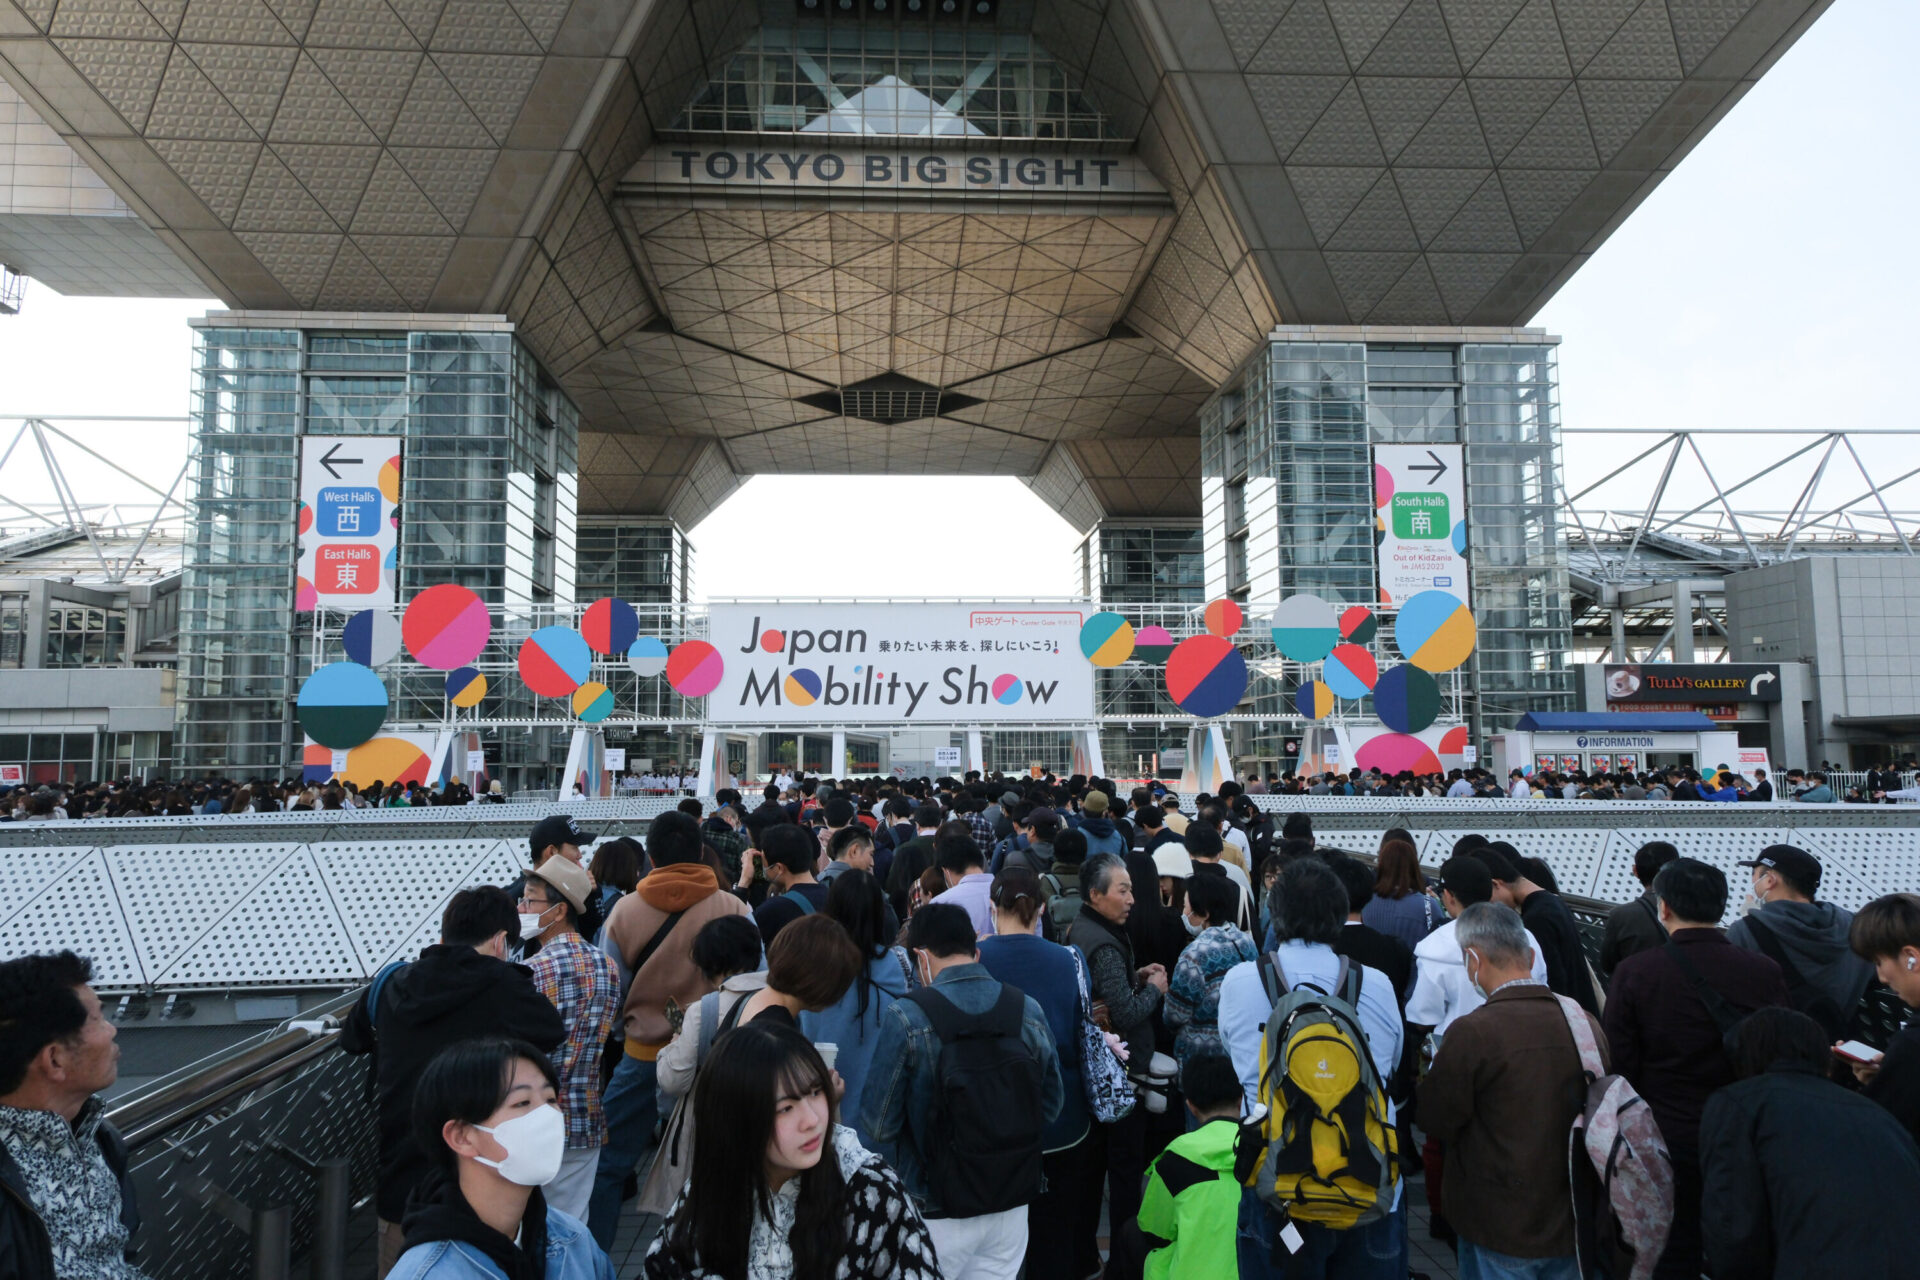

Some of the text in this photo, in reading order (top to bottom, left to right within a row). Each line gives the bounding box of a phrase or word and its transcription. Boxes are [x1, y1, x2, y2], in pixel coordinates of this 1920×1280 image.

[671, 150, 1119, 187] TOKYO BIG SIGHT
[324, 491, 375, 502] West Halls
[1395, 496, 1445, 507] South Halls
[337, 505, 361, 532] 西
[1410, 509, 1431, 535] 南
[324, 549, 371, 560] East Halls
[336, 562, 359, 590] 東
[975, 616, 1019, 626] 中央ゲート
[740, 616, 868, 665] Japan
[739, 664, 1060, 717] Mobility Show
[1694, 679, 1747, 689] GALLERY
[1589, 737, 1654, 747] INFORMATION
